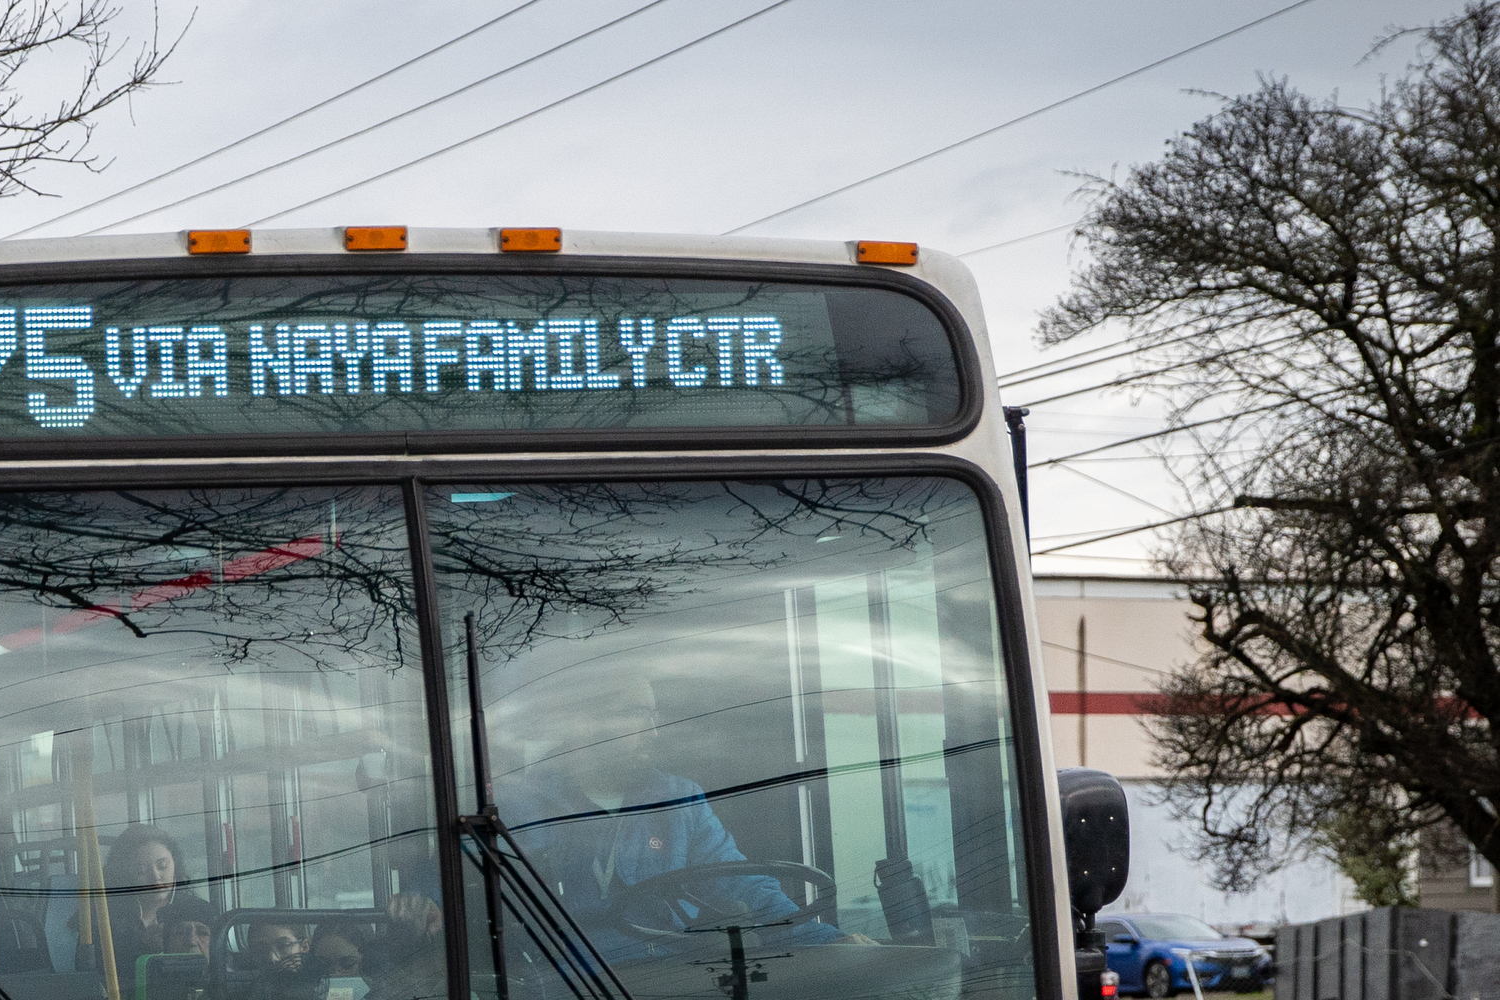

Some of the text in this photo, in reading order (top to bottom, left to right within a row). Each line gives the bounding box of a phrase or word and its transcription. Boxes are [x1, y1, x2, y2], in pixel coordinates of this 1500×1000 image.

[105, 315, 785, 398] VIA NAYA FAMILY CTR
